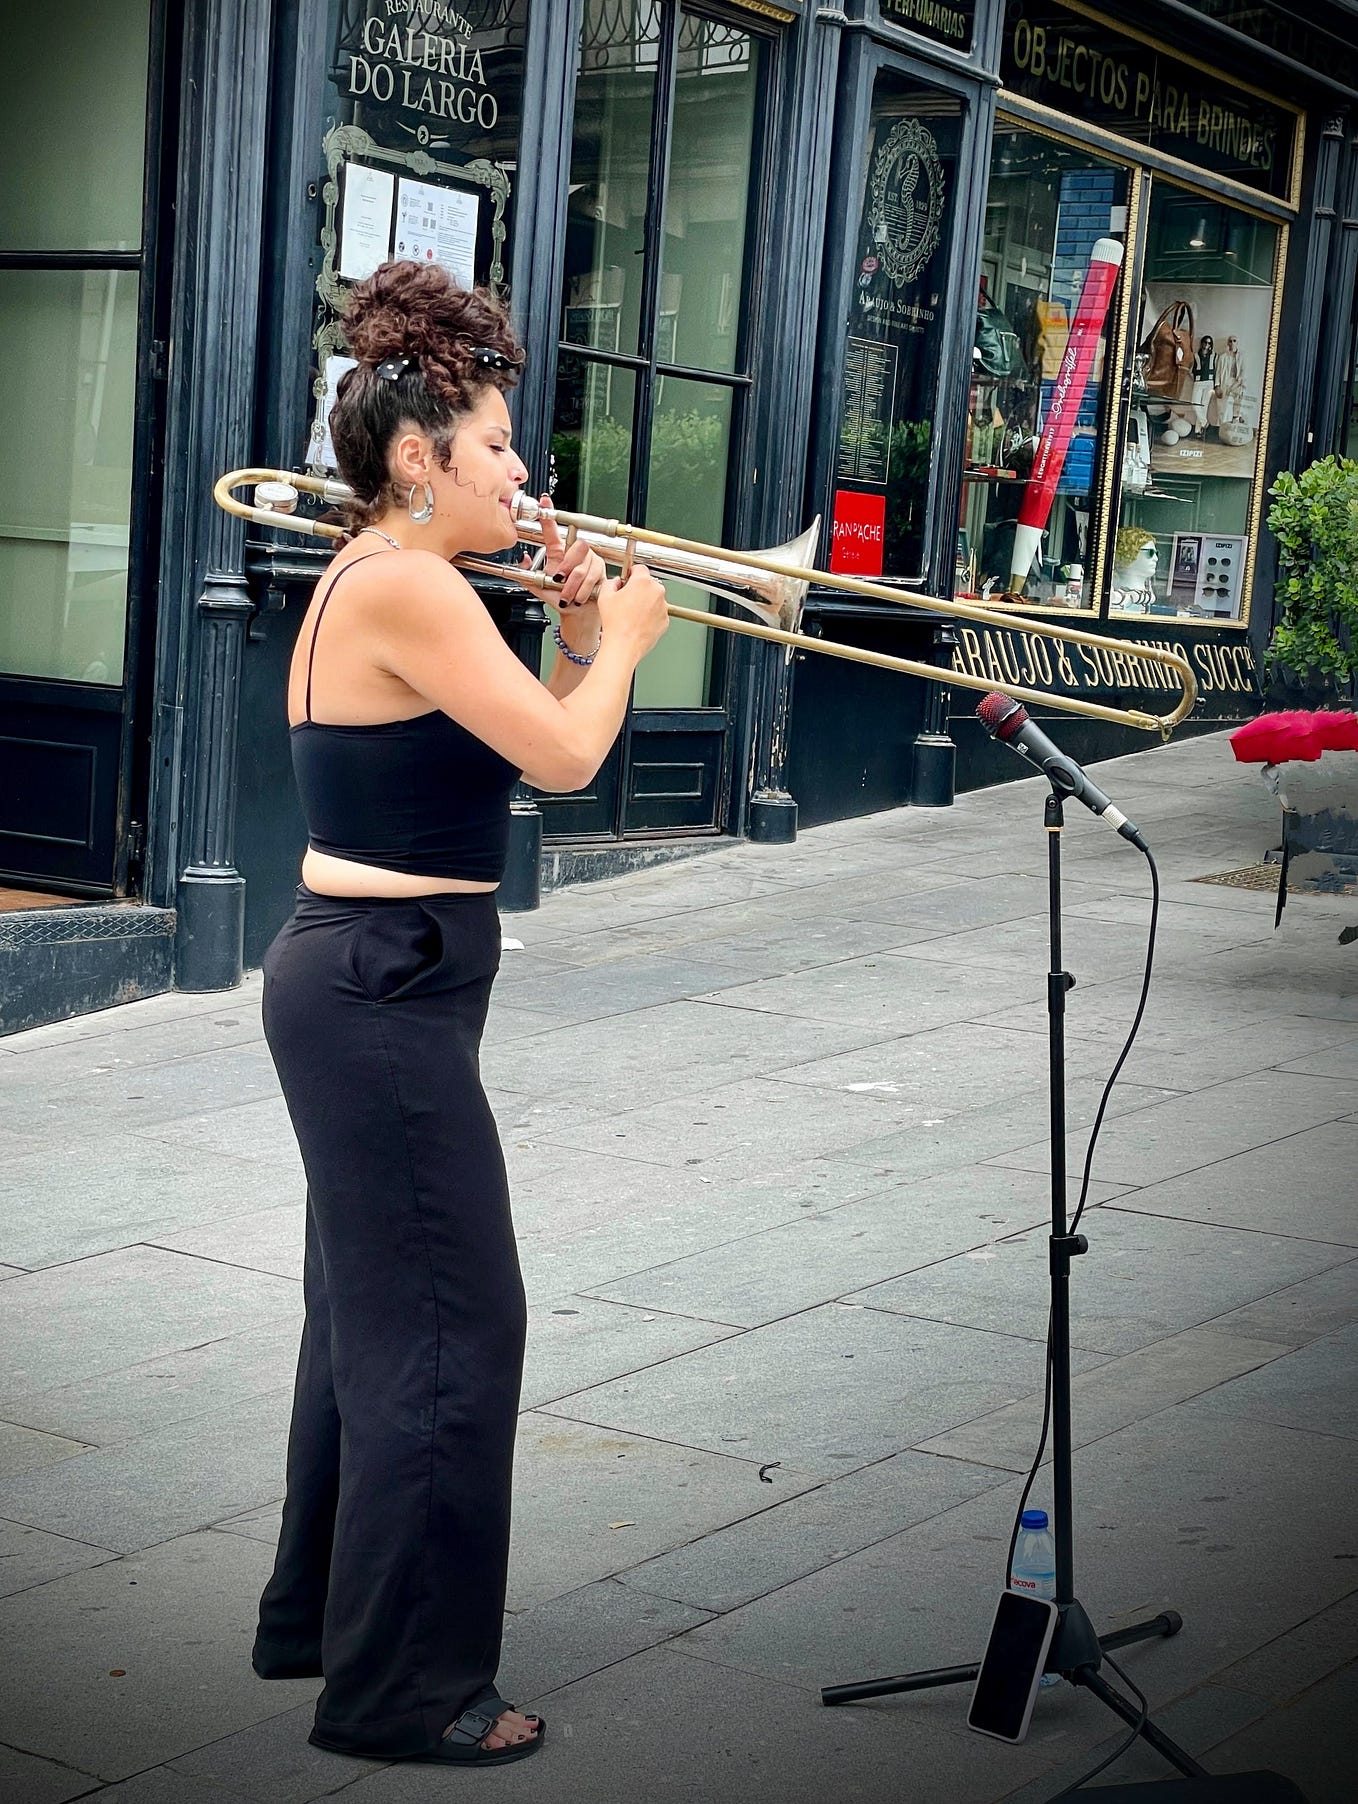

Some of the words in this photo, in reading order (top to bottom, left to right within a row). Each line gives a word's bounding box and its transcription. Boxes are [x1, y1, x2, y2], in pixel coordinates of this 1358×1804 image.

[364, 17, 487, 86] GALERIA
[385, 0, 473, 40] RESTAURANTE
[348, 55, 394, 102] DO
[401, 71, 498, 130] LARGO
[1014, 19, 1129, 110] OBJECTOS
[1135, 72, 1191, 140] PARA
[1197, 104, 1273, 170] BRINDES
[890, 302, 896, 312] &
[952, 628, 1053, 686] ARAUJO
[1053, 638, 1079, 687] &
